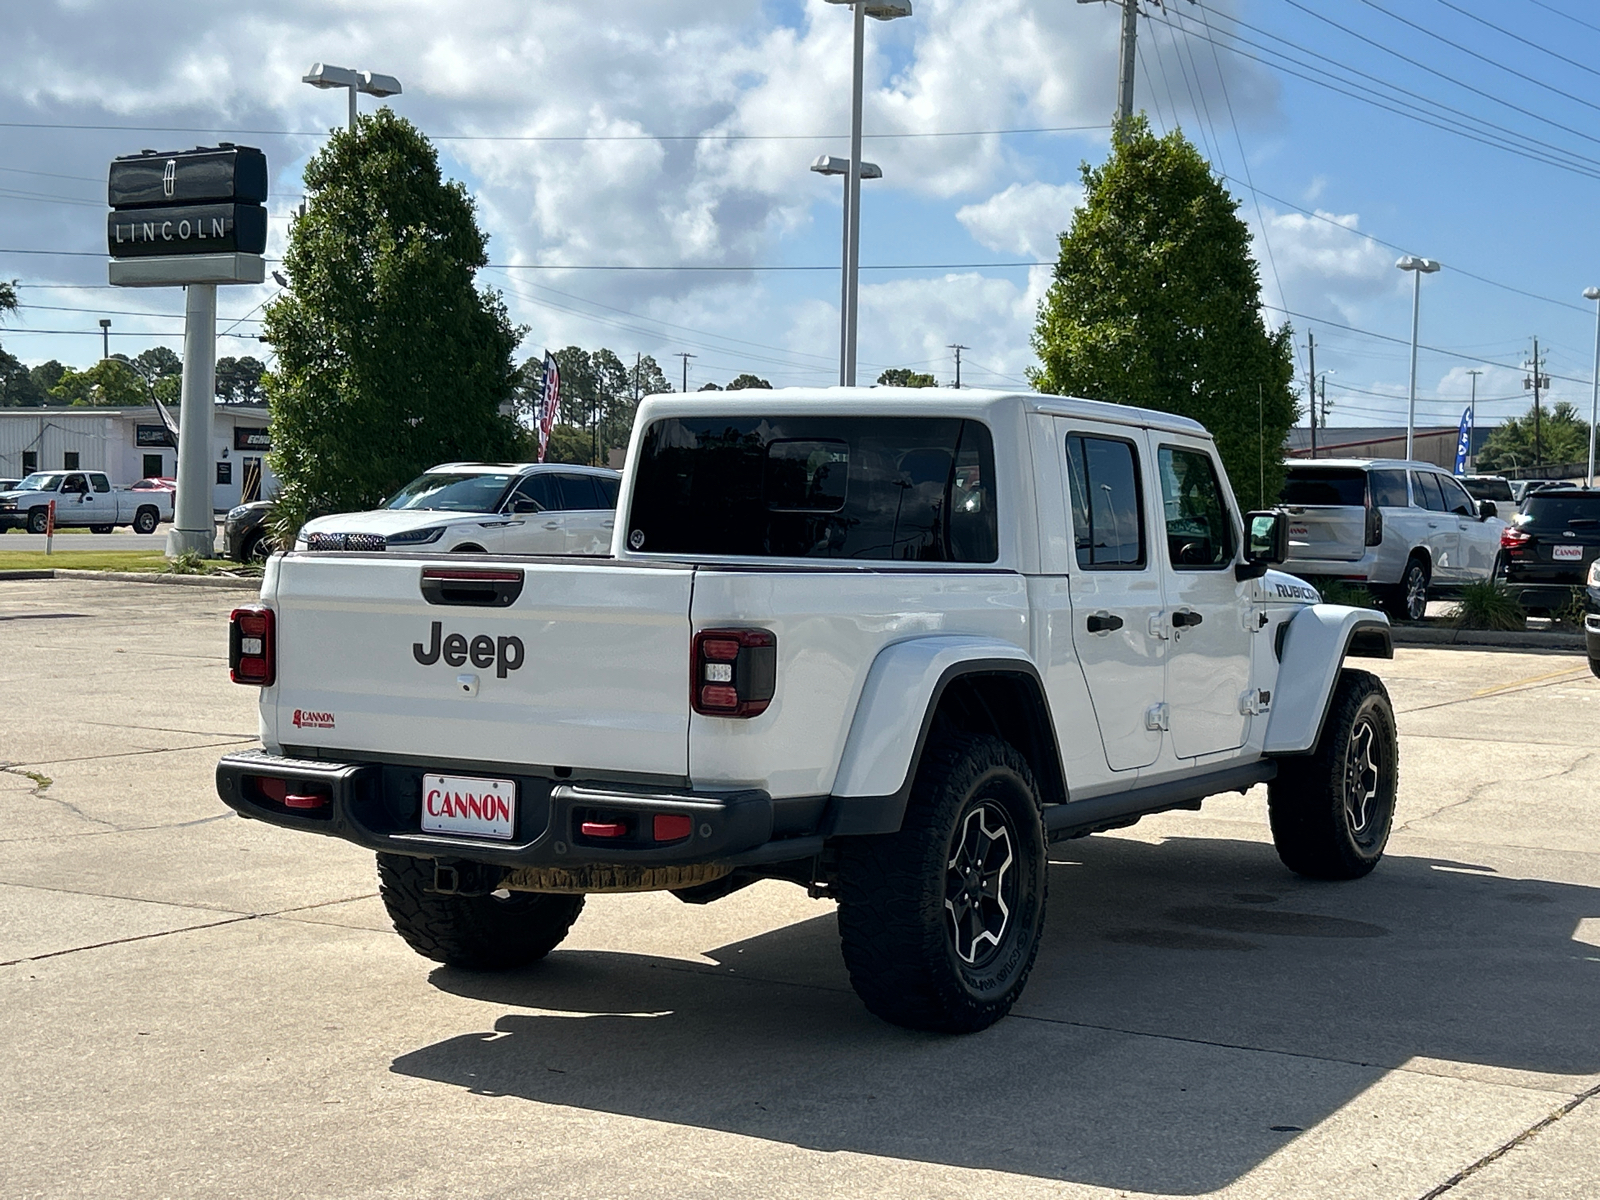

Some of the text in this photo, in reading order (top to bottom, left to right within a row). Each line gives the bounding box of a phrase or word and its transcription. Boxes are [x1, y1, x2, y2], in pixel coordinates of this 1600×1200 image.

[116, 218, 225, 243] LINCOLN
[1555, 548, 1581, 557] CANNON
[1275, 583, 1321, 603] RUBICON
[413, 621, 525, 679] Jeep
[302, 711, 335, 723] CANNON
[426, 790, 510, 823] CANNON
[998, 838, 1037, 985] PATAGONIA
